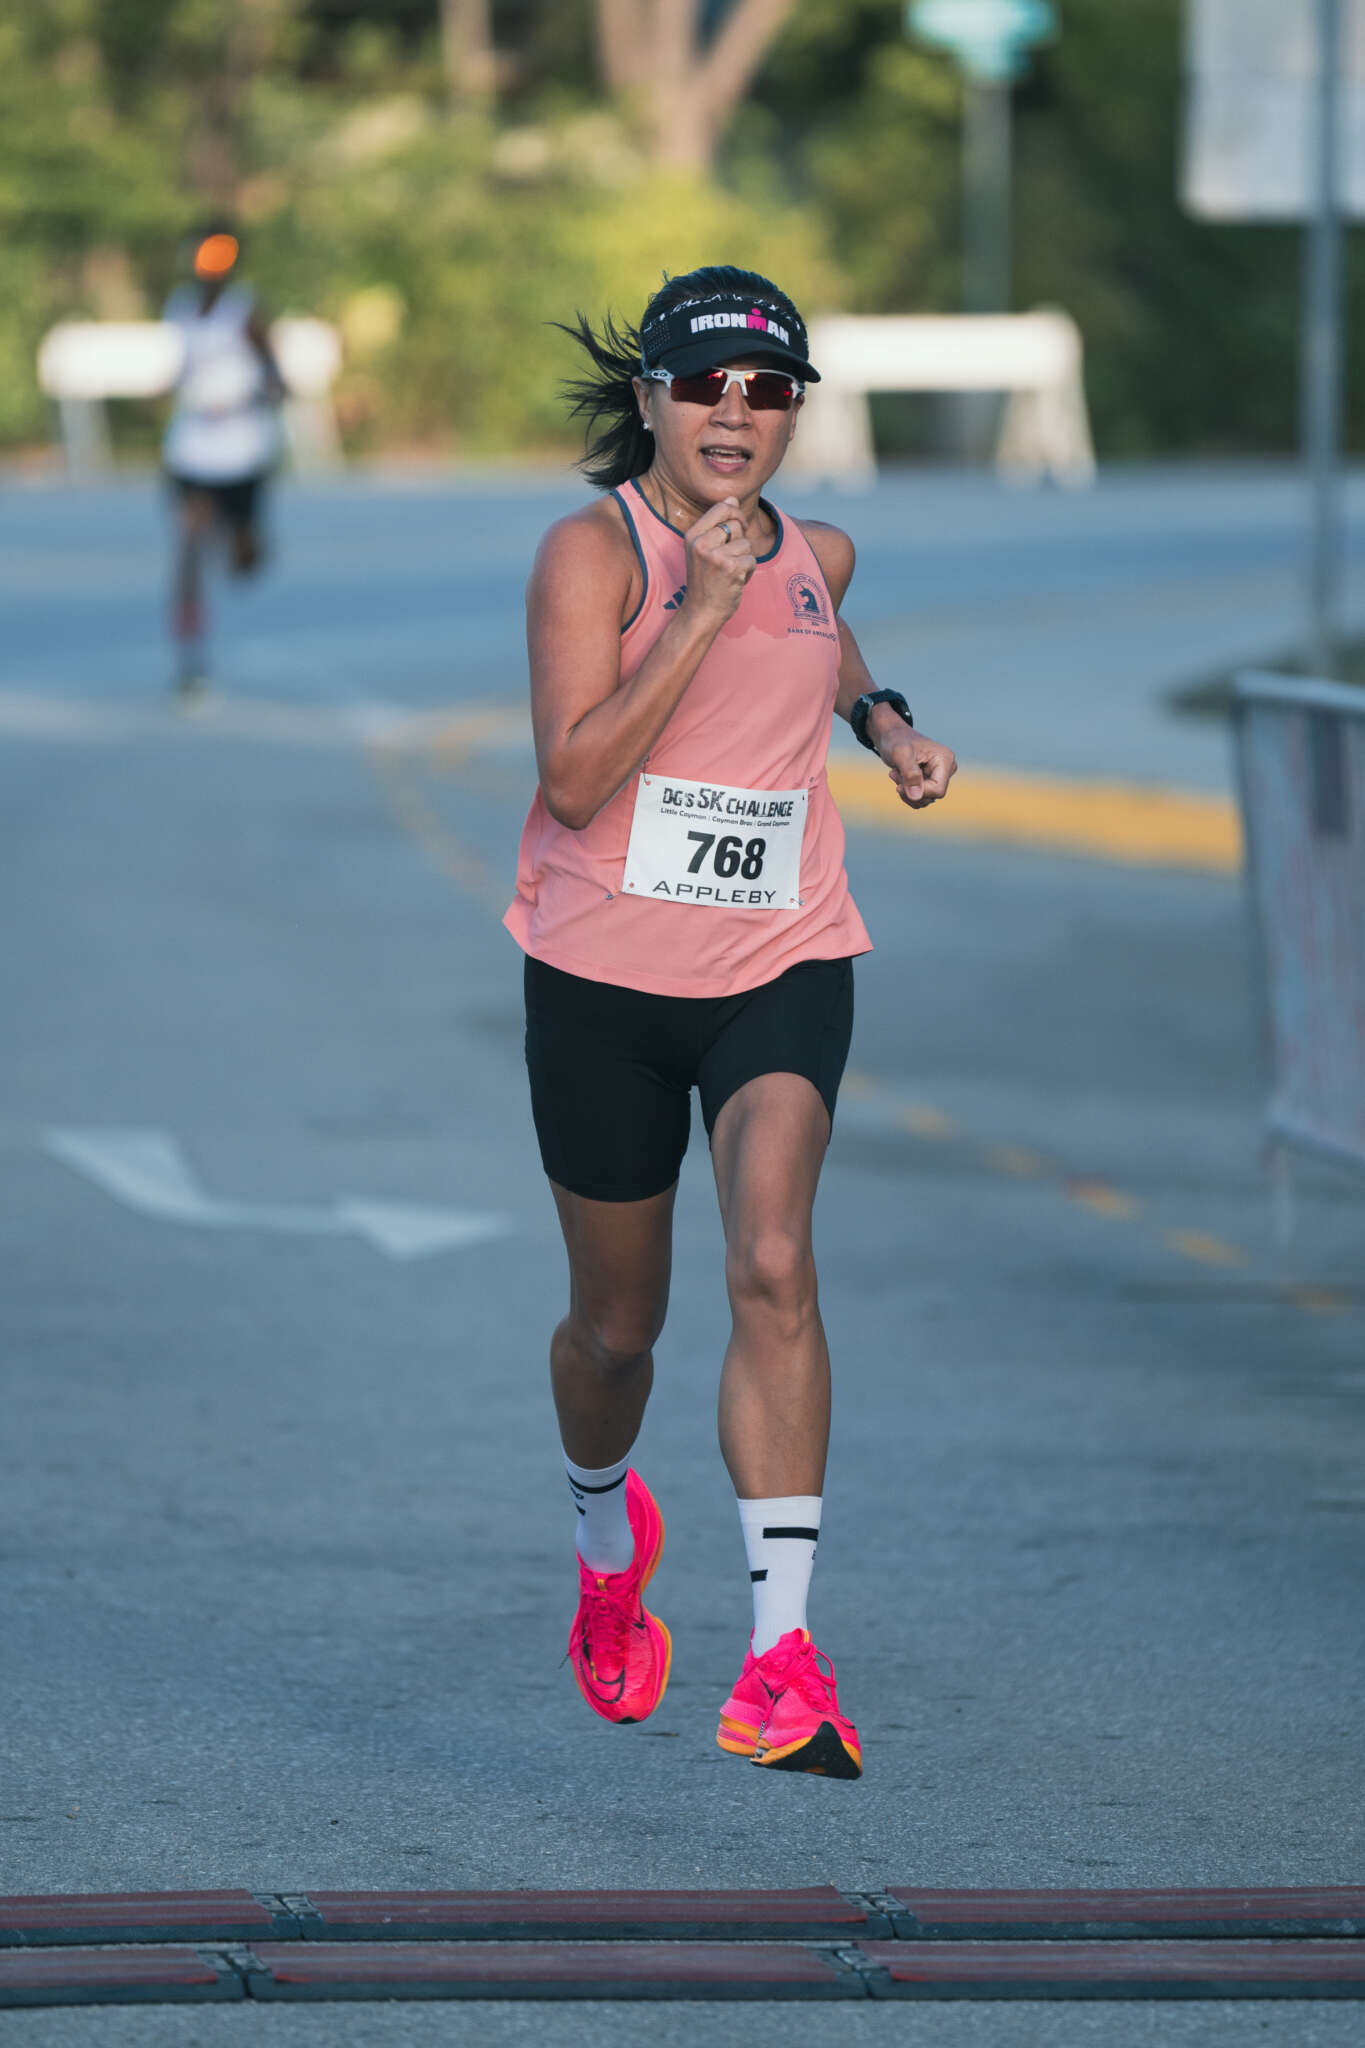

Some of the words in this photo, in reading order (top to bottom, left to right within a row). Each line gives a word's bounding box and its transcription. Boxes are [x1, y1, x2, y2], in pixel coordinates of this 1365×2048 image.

[690, 308, 790, 346] IRONMAN
[697, 787, 726, 812] 5K
[726, 798, 794, 817] CHALLENGE
[687, 830, 766, 880] 768
[652, 880, 776, 904] APPLEBY
